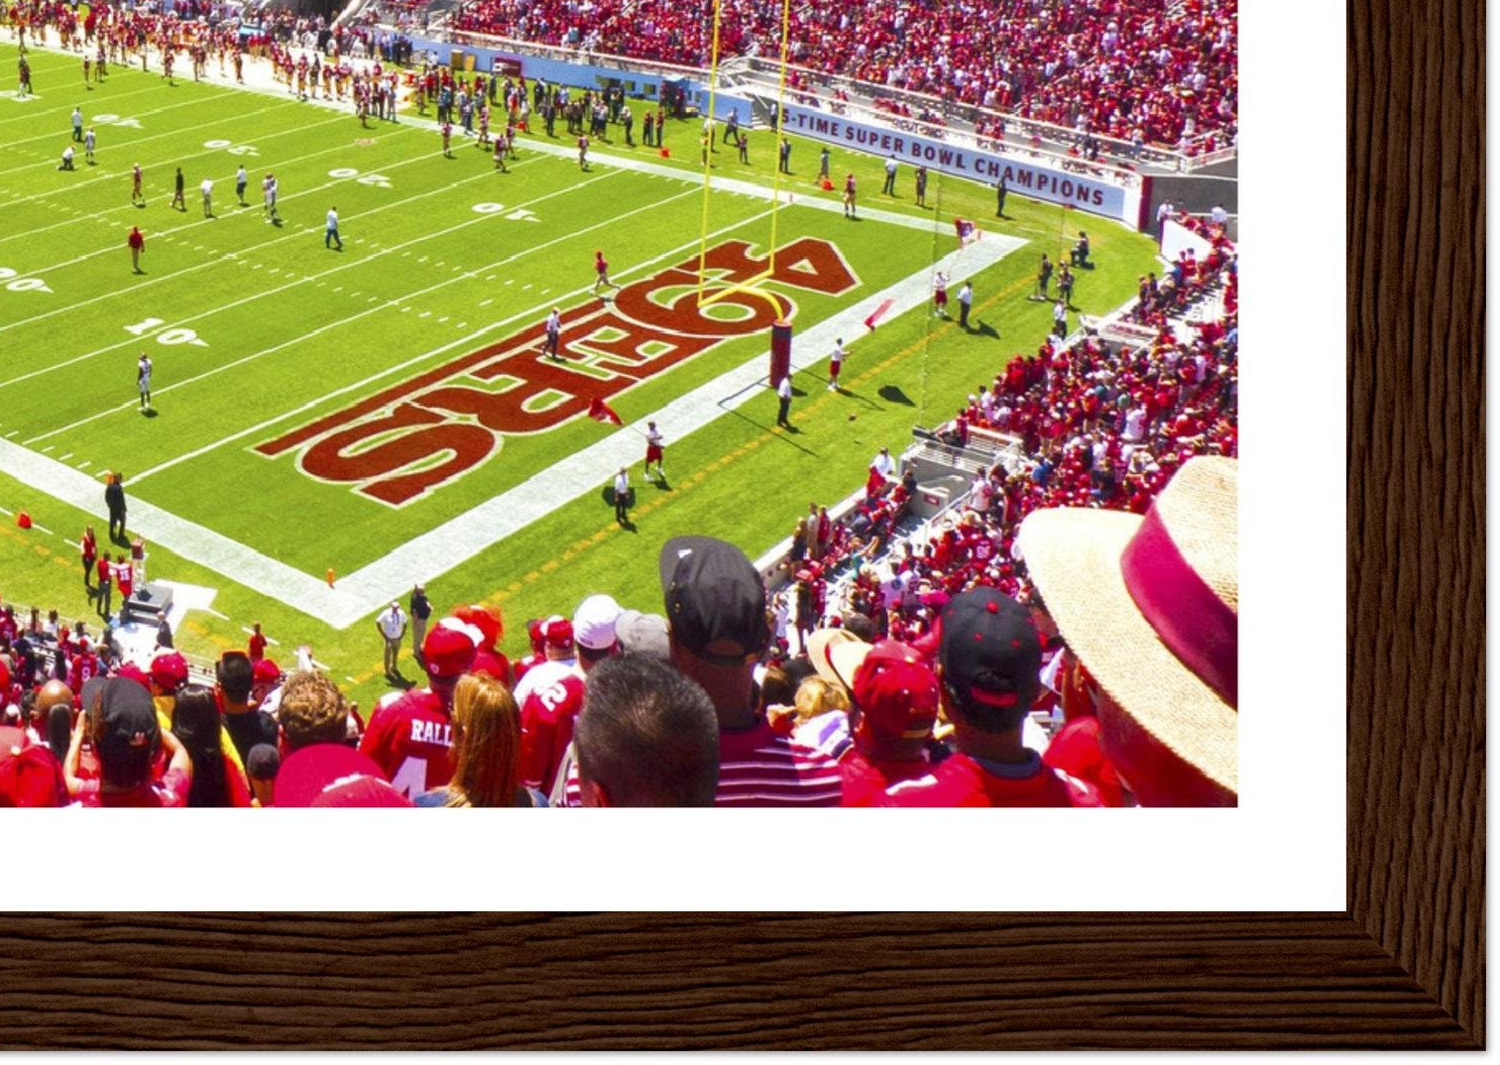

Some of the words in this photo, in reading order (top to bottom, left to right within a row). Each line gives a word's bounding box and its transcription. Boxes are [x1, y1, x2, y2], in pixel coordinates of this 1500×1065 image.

[781, 107, 839, 137] 5-TIME
[845, 126, 903, 154] SUPER
[910, 142, 966, 170] BOWL
[974, 158, 1104, 206] CHAMPIONS
[123, 317, 209, 347] 10
[245, 236, 861, 509] 49ERS
[410, 718, 453, 748] RALL
